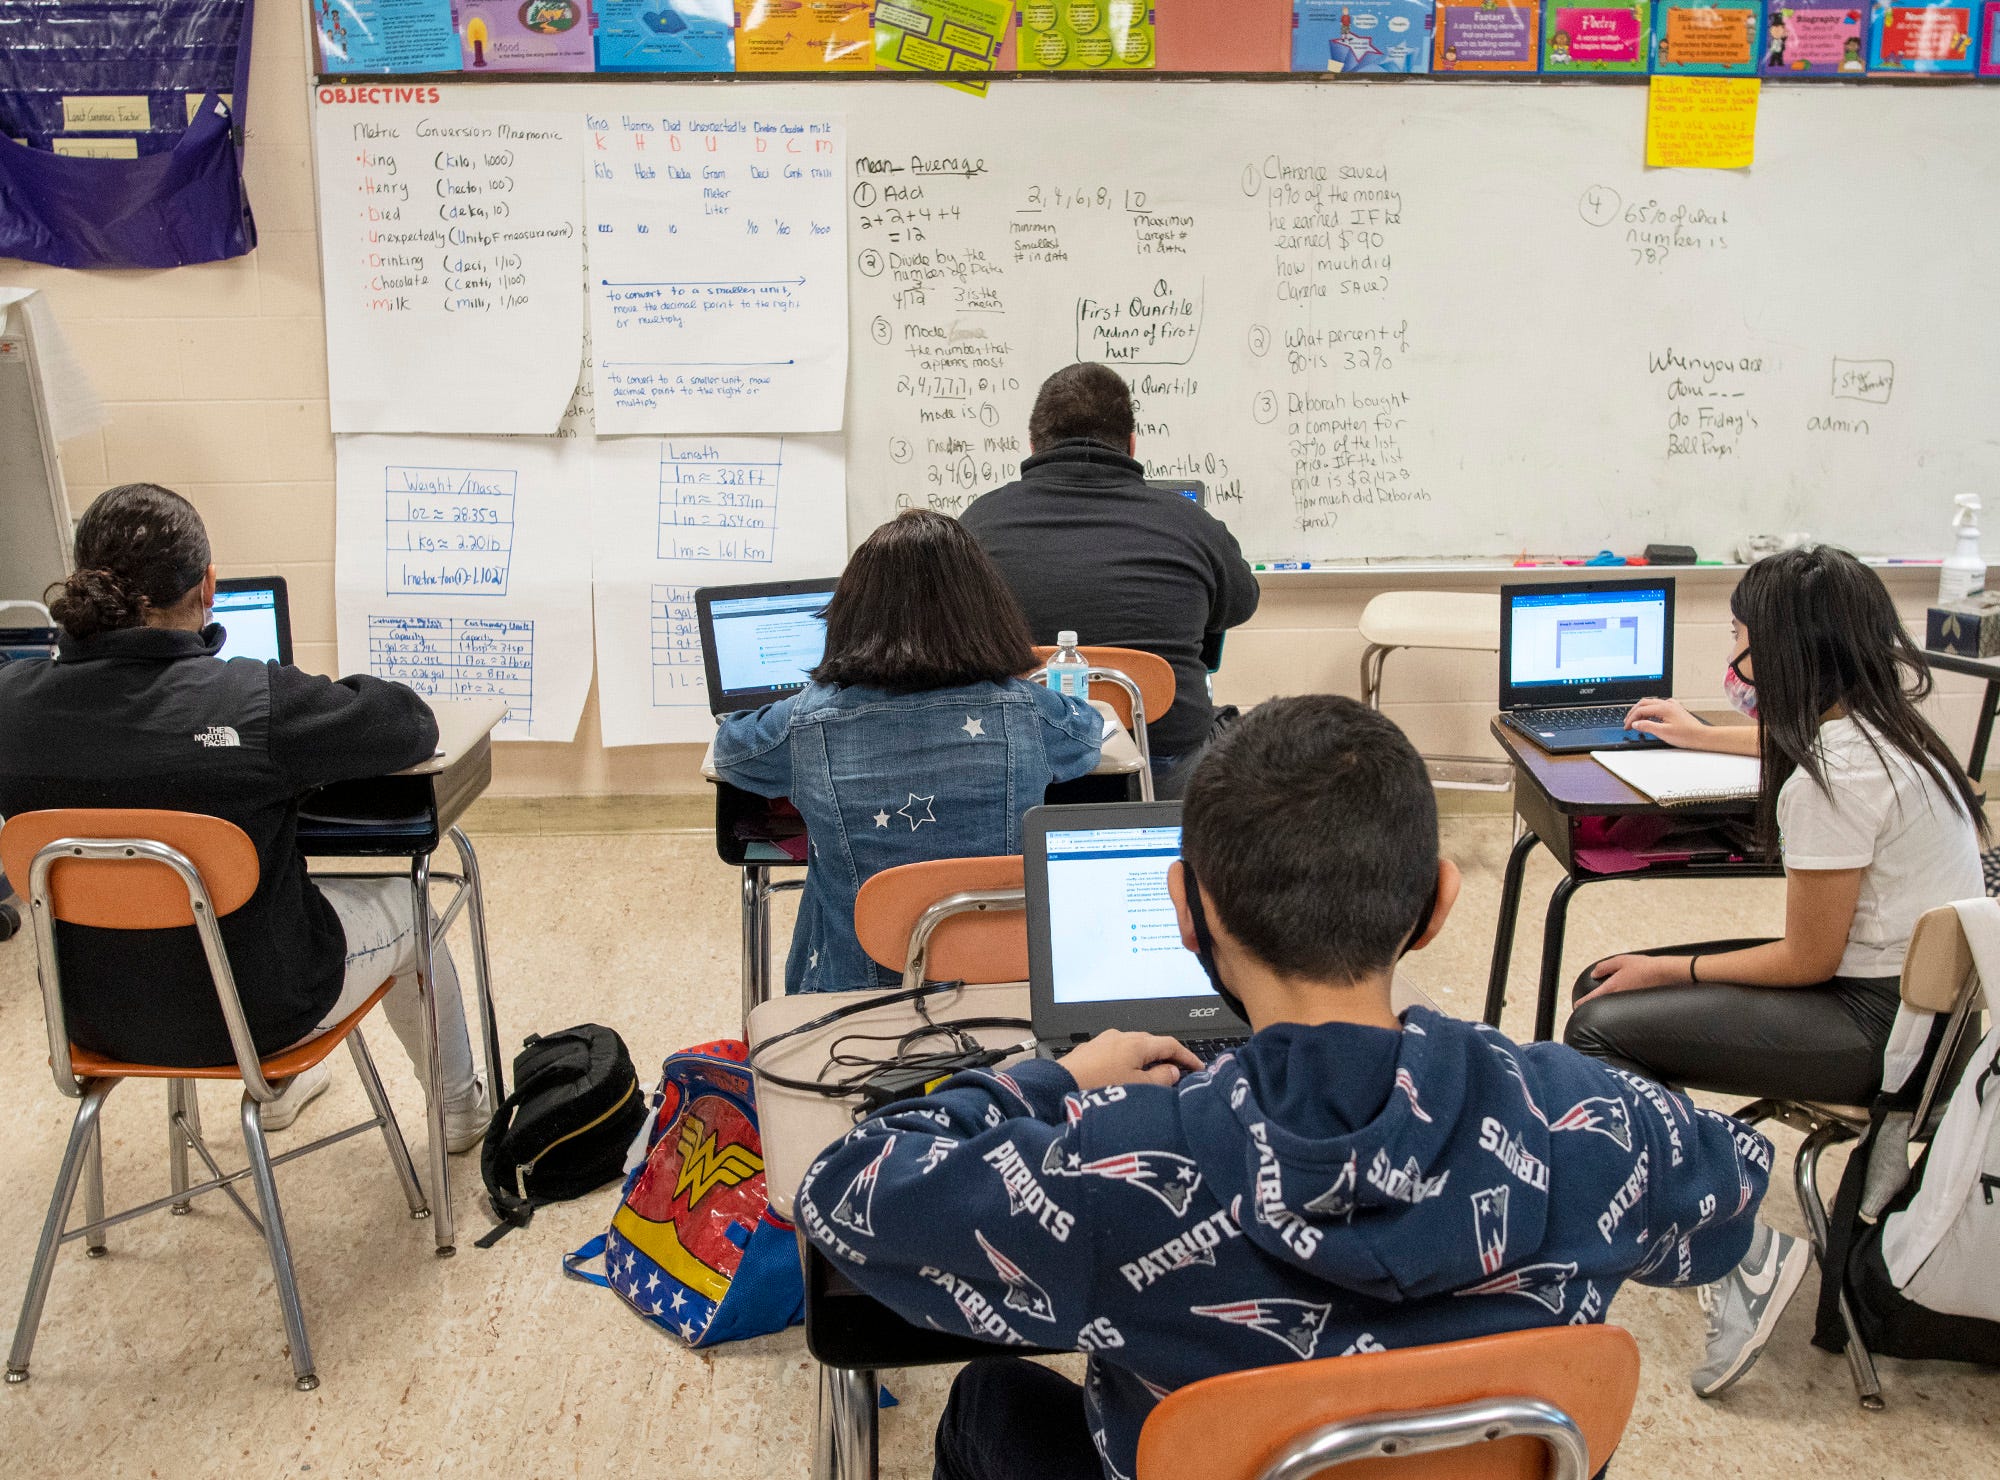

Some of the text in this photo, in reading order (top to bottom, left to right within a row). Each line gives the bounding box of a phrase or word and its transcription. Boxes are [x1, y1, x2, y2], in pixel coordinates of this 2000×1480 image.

[1796, 15, 1841, 23] Biography
[319, 87, 440, 104] OBJECTIVES
[354, 119, 562, 140] Metric Conversion Mnemonic
[595, 132, 607, 150] K
[635, 133, 645, 151] H
[670, 133, 681, 151] D
[705, 136, 717, 151] U
[756, 136, 767, 152] D
[786, 138, 801, 153] C
[912, 156, 988, 178] Average
[1339, 165, 1387, 182] saved
[365, 176, 409, 201] Henry
[703, 187, 732, 199] Meter
[884, 185, 924, 202] Add
[1328, 184, 1348, 204] the
[1353, 189, 1402, 213] money
[369, 204, 401, 221] Died
[705, 204, 730, 215] Liter
[1624, 199, 1666, 225] 65%
[1689, 209, 1729, 224] what
[1269, 211, 1286, 231] he
[1292, 212, 1339, 230] earned
[369, 223, 446, 249] Unexpectedly
[1274, 232, 1330, 250] earned
[1626, 226, 1729, 249] number is
[369, 254, 424, 271] Drinking
[889, 249, 986, 269] Divide by the
[1276, 254, 1391, 276] how much did
[372, 275, 430, 291] Chocolate
[893, 267, 944, 281] number
[607, 291, 622, 301] to
[625, 290, 662, 299] convert
[1277, 281, 1327, 301] Clarence
[613, 305, 638, 314] move
[703, 300, 735, 311] point
[968, 301, 1002, 309] mean
[617, 318, 629, 329] or
[1285, 327, 1323, 348] What
[1328, 326, 1389, 344] percent
[935, 345, 982, 355] number
[985, 342, 1013, 354] that
[972, 358, 1004, 368] most
[1313, 356, 1328, 368] is
[1344, 347, 1393, 370] 32%
[1649, 348, 1701, 374] When
[1703, 358, 1735, 383] you
[962, 405, 977, 419] is
[1288, 391, 1410, 415] Deborah bought
[1288, 413, 1407, 435] a computer for
[1669, 406, 1689, 430] do
[1807, 416, 1869, 435] admin
[670, 442, 719, 460] Length
[1351, 436, 1370, 449] the
[1374, 436, 1397, 449] list
[1381, 449, 1404, 464] list
[403, 471, 452, 492] Weight
[1318, 487, 1431, 505] much did Deborah
[744, 539, 764, 559] km
[1579, 687, 1596, 695] acer
[194, 733, 225, 741] NORTH
[207, 726, 225, 734] THE
[1189, 1006, 1219, 1018] acer
[983, 1139, 1075, 1243] PATRIOTS
[800, 1160, 868, 1266] PATRIOTS
[1119, 1209, 1243, 1293] PATRIOT
[918, 1265, 1038, 1346] PATRIOT
